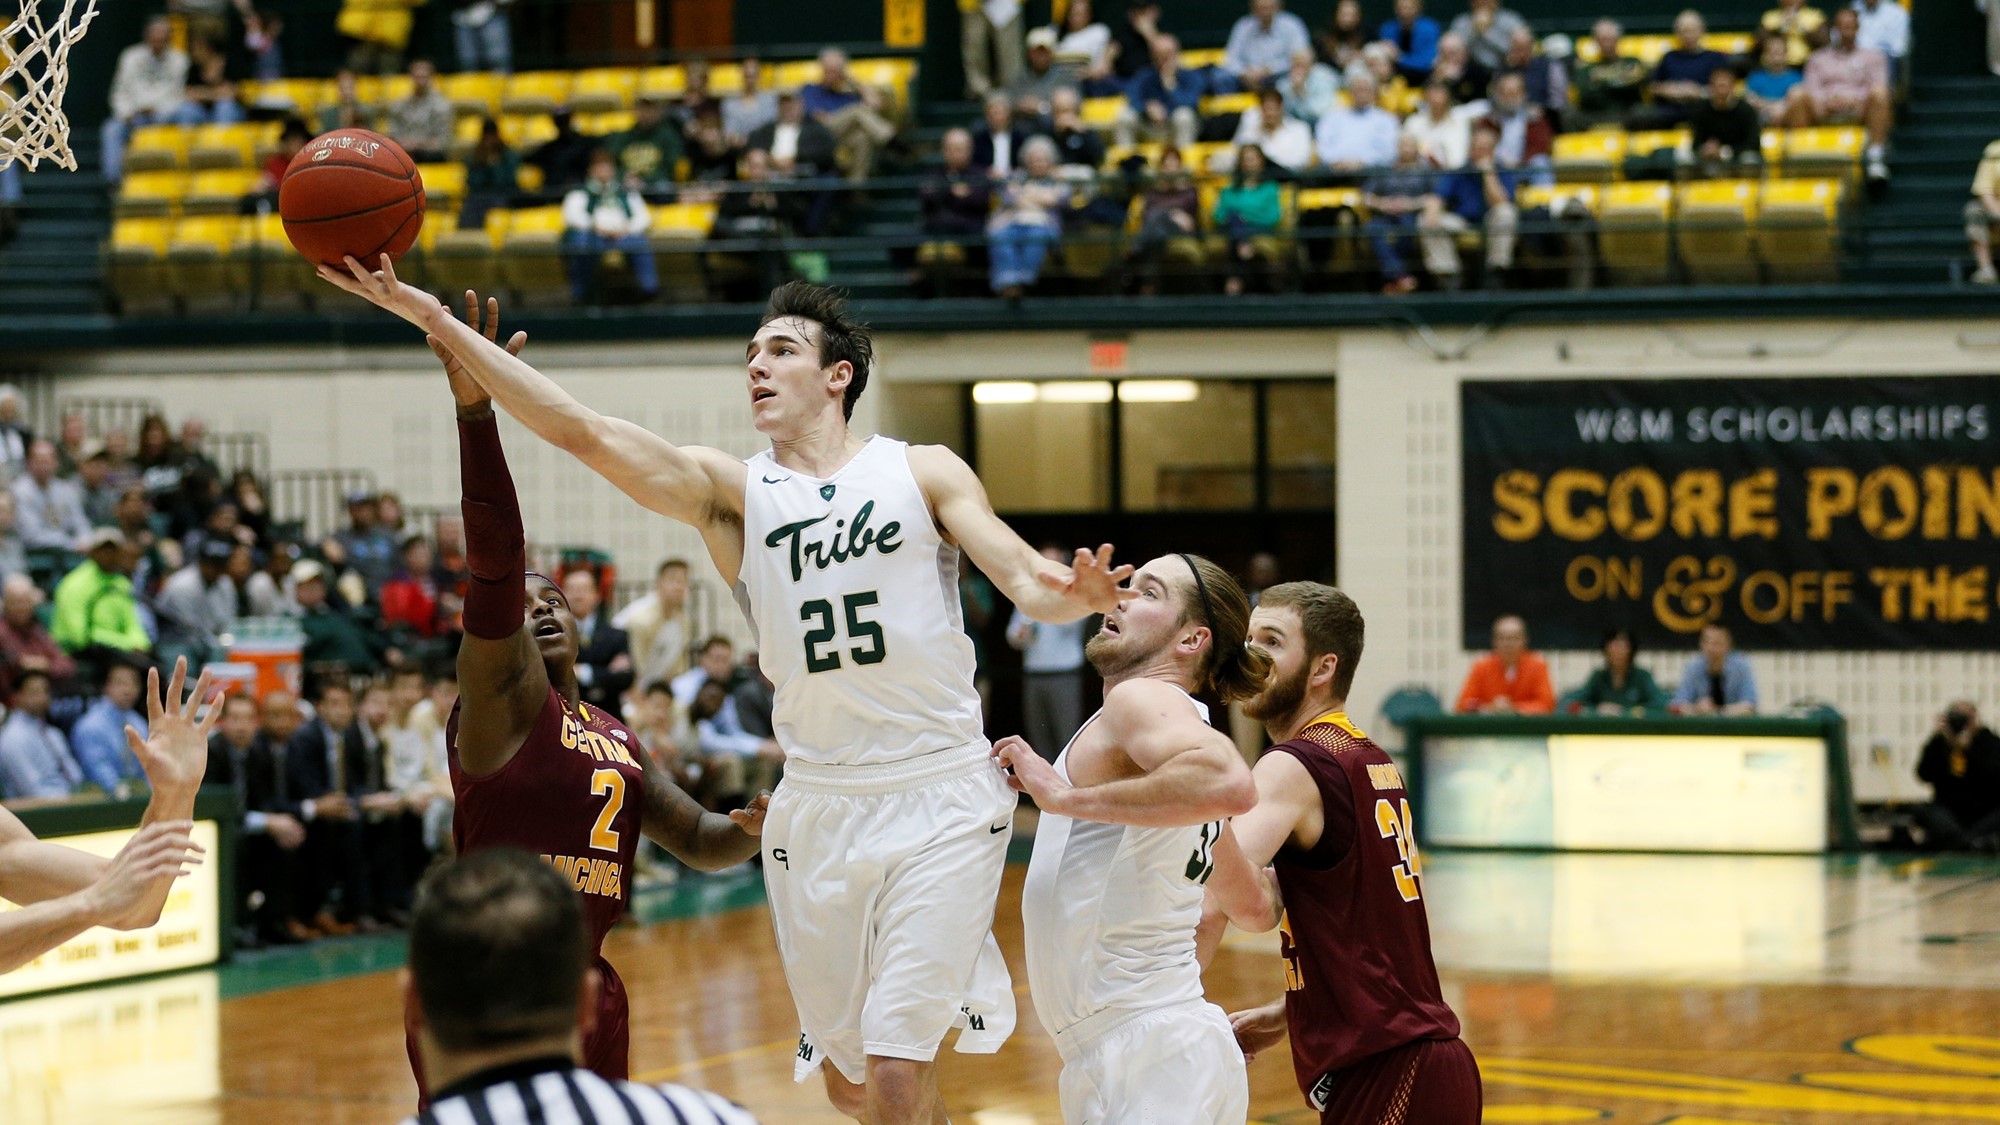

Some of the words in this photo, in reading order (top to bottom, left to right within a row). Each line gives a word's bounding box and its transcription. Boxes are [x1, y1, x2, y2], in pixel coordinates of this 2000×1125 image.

[1575, 406, 1673, 443] W&M
[1686, 403, 1989, 442] SCHOLARSHIPS
[764, 498, 905, 584] Tribe
[1491, 467, 1779, 541] SCORE
[800, 589, 887, 674] 25
[1565, 555, 1643, 601] ON
[1653, 555, 1736, 633] &
[1740, 570, 1854, 624] OFF
[1869, 563, 1989, 623] THE
[589, 768, 626, 852] 2
[1375, 798, 1420, 902] 34
